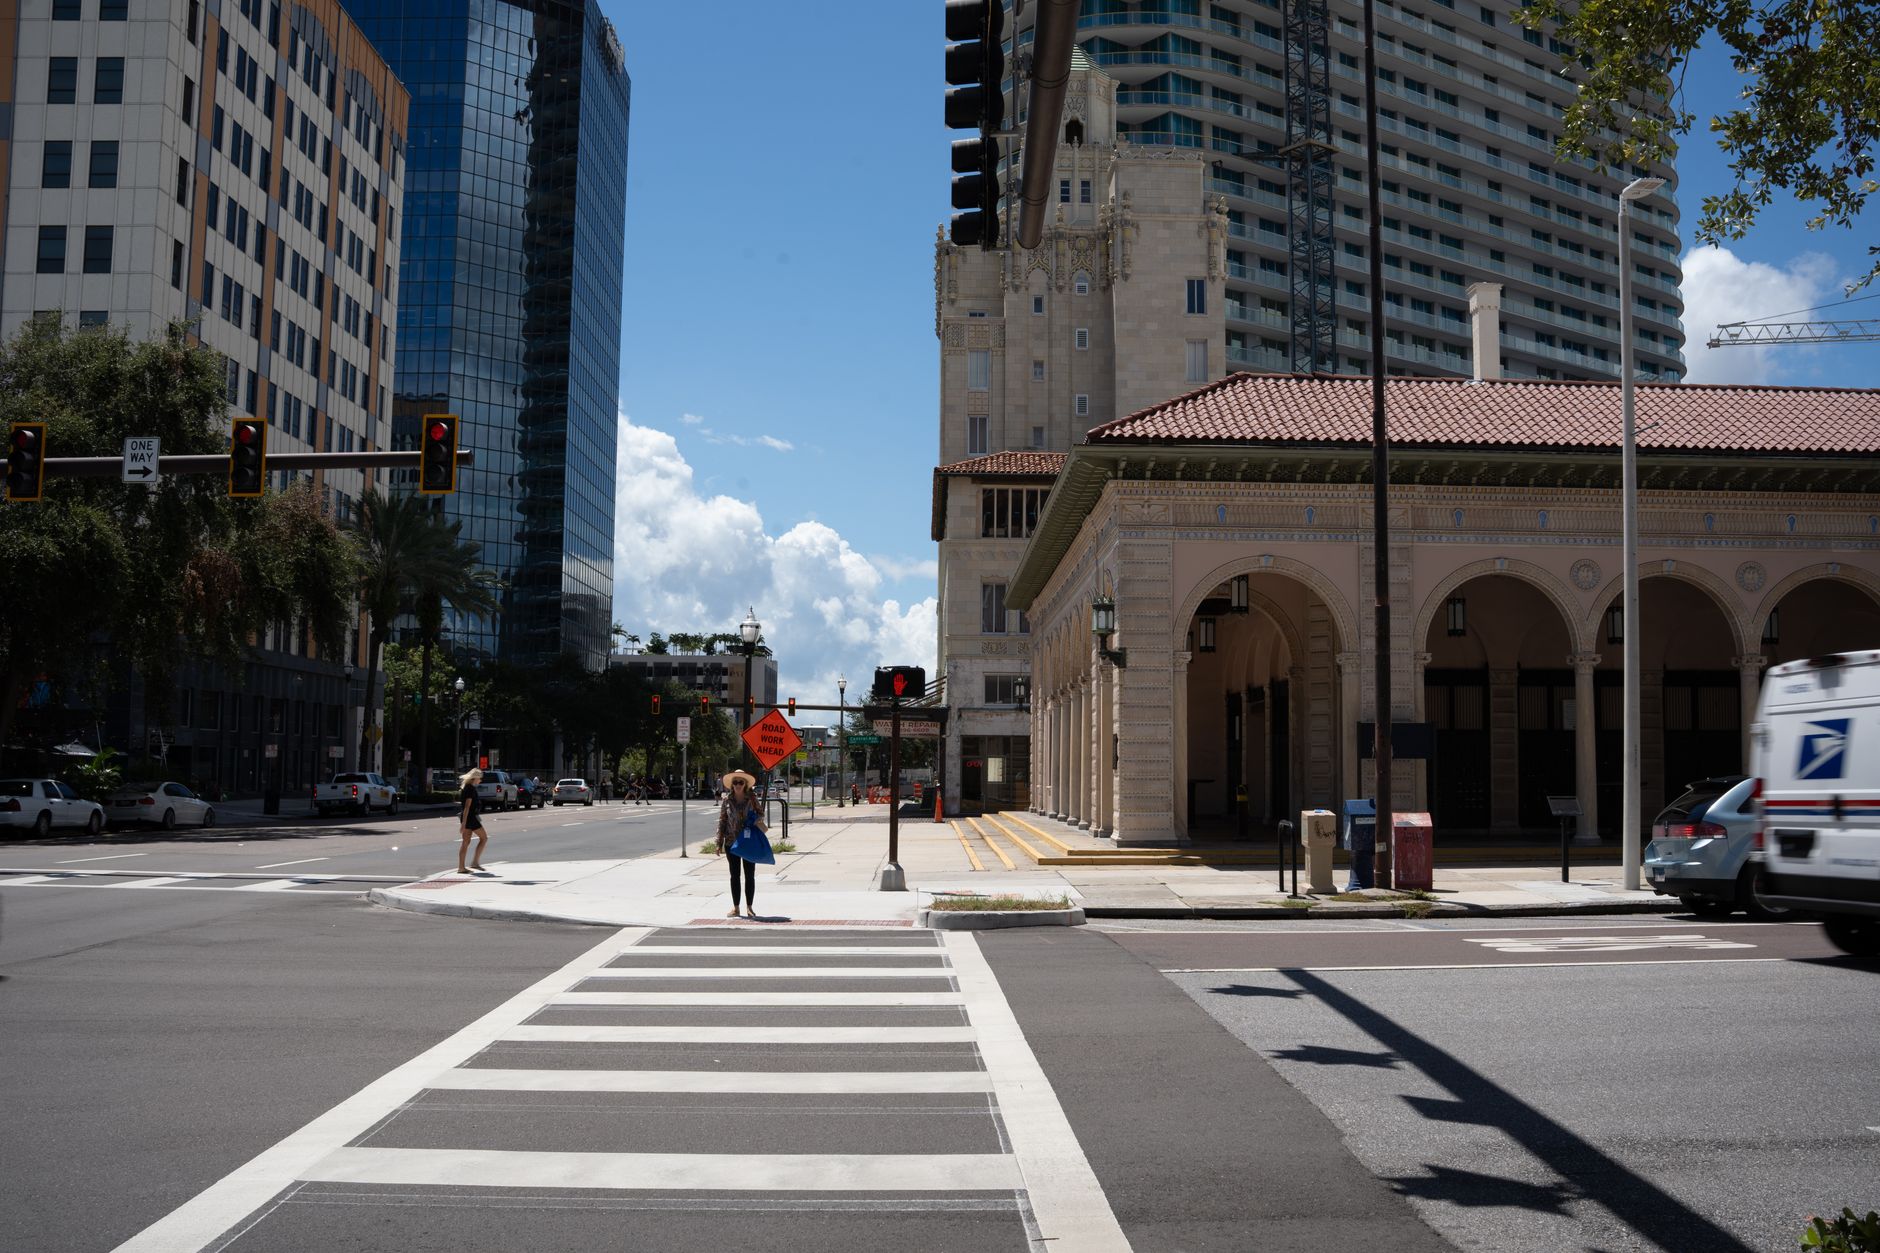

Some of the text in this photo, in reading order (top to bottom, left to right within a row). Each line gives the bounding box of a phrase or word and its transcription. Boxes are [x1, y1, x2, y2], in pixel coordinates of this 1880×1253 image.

[130, 440, 153, 450] ONE
[130, 452, 153, 463] WAY
[761, 723, 786, 734] ROAD
[875, 720, 939, 729] WATH REPAIR
[760, 734, 784, 745] WORK
[757, 745, 785, 757] AHEAD
